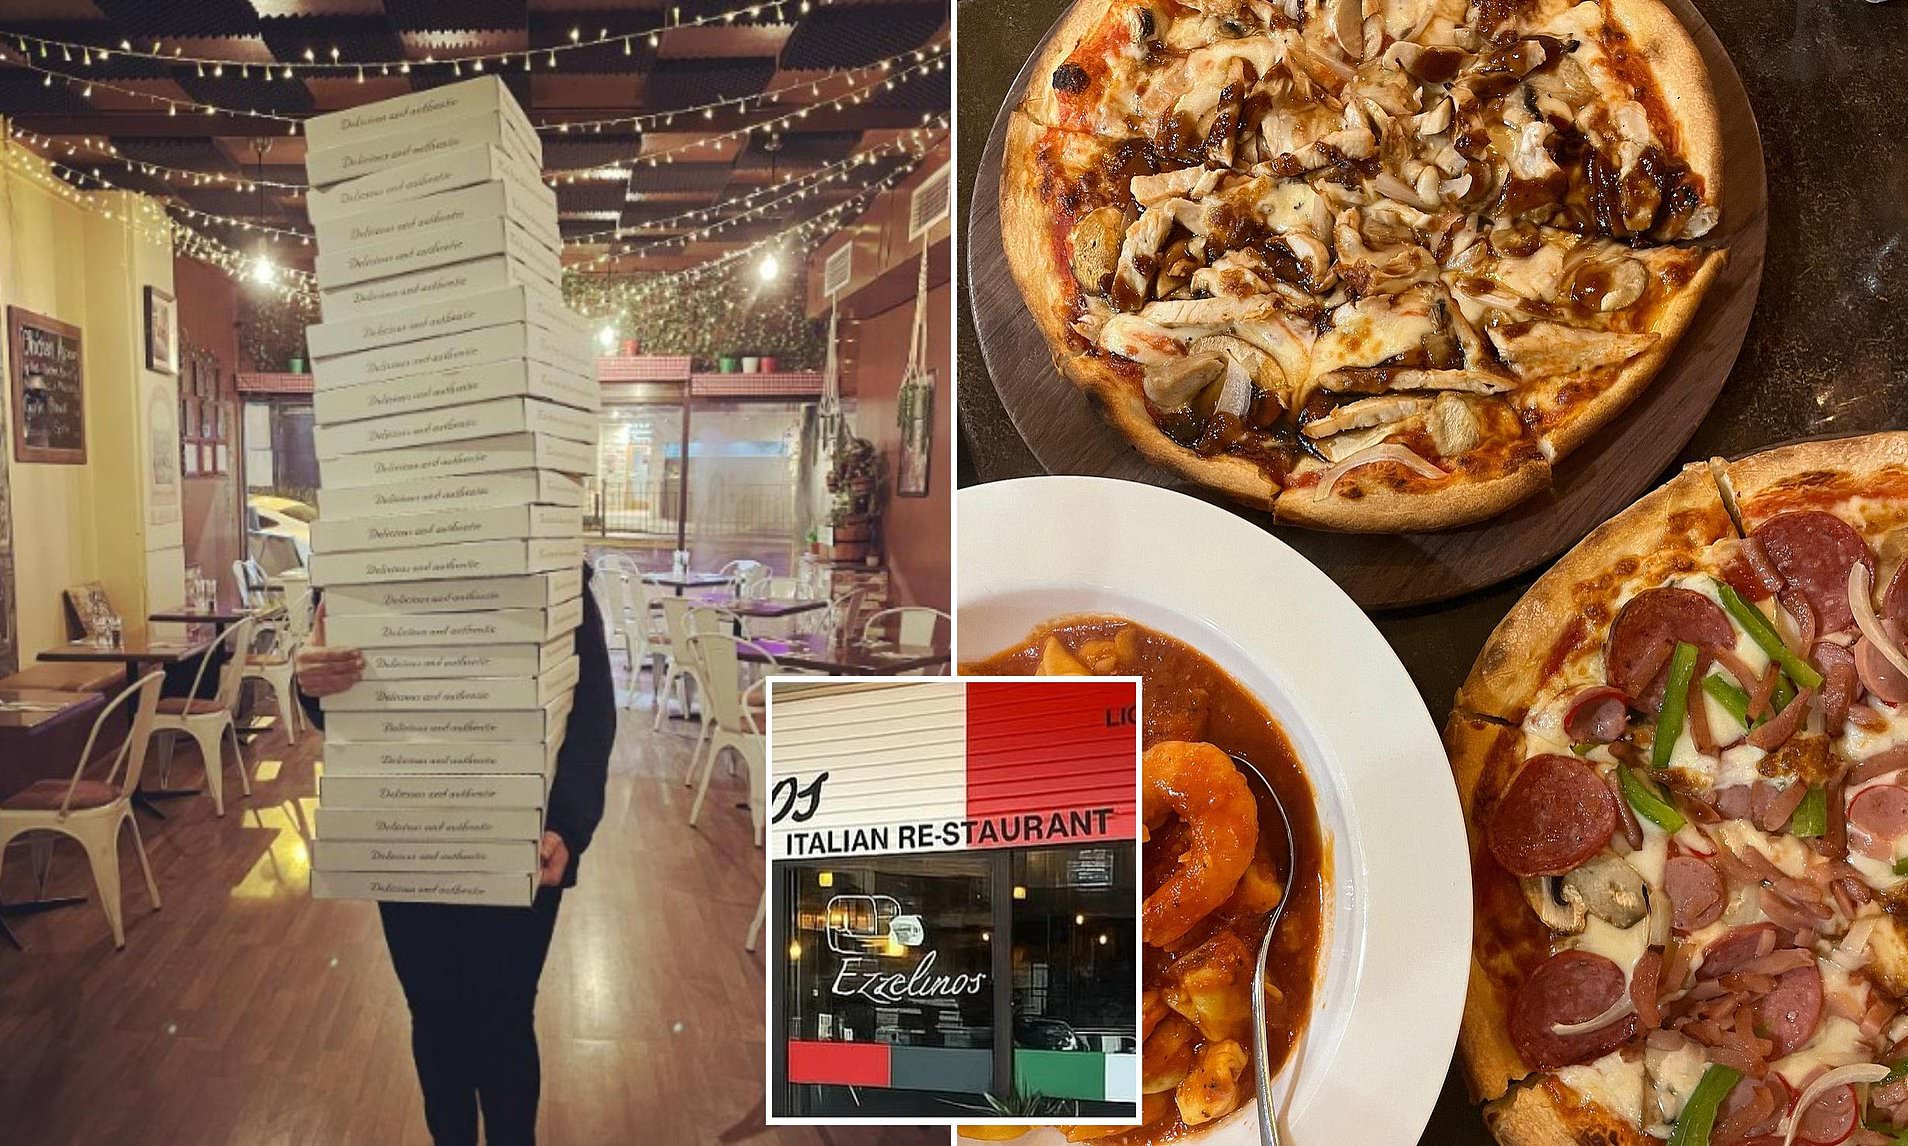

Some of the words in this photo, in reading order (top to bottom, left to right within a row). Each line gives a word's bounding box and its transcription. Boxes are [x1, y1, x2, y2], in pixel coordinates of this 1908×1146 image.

[389, 106, 409, 119] and
[391, 145, 410, 158] and
[385, 180, 404, 193] and
[398, 217, 416, 231] and
[396, 250, 414, 260] and
[402, 284, 419, 295] and
[410, 317, 428, 330] and
[414, 354, 431, 364] and
[413, 387, 431, 399] and
[414, 422, 431, 433] and
[421, 457, 440, 468] and
[422, 490, 440, 500] and
[415, 524, 434, 535] and
[412, 560, 430, 571] and
[433, 592, 450, 603] and
[429, 625, 448, 635] and
[424, 656, 441, 667] and
[423, 690, 440, 701] and
[429, 722, 449, 732] and
[429, 755, 448, 765] and
[428, 787, 448, 798] and
[424, 820, 443, 831] and
[787, 827, 888, 855] ITALIAN
[899, 808, 1114, 849] RE-STAURANT
[420, 849, 438, 860] and
[418, 884, 437, 893] and
[832, 950, 986, 1004] Ezzelinos
